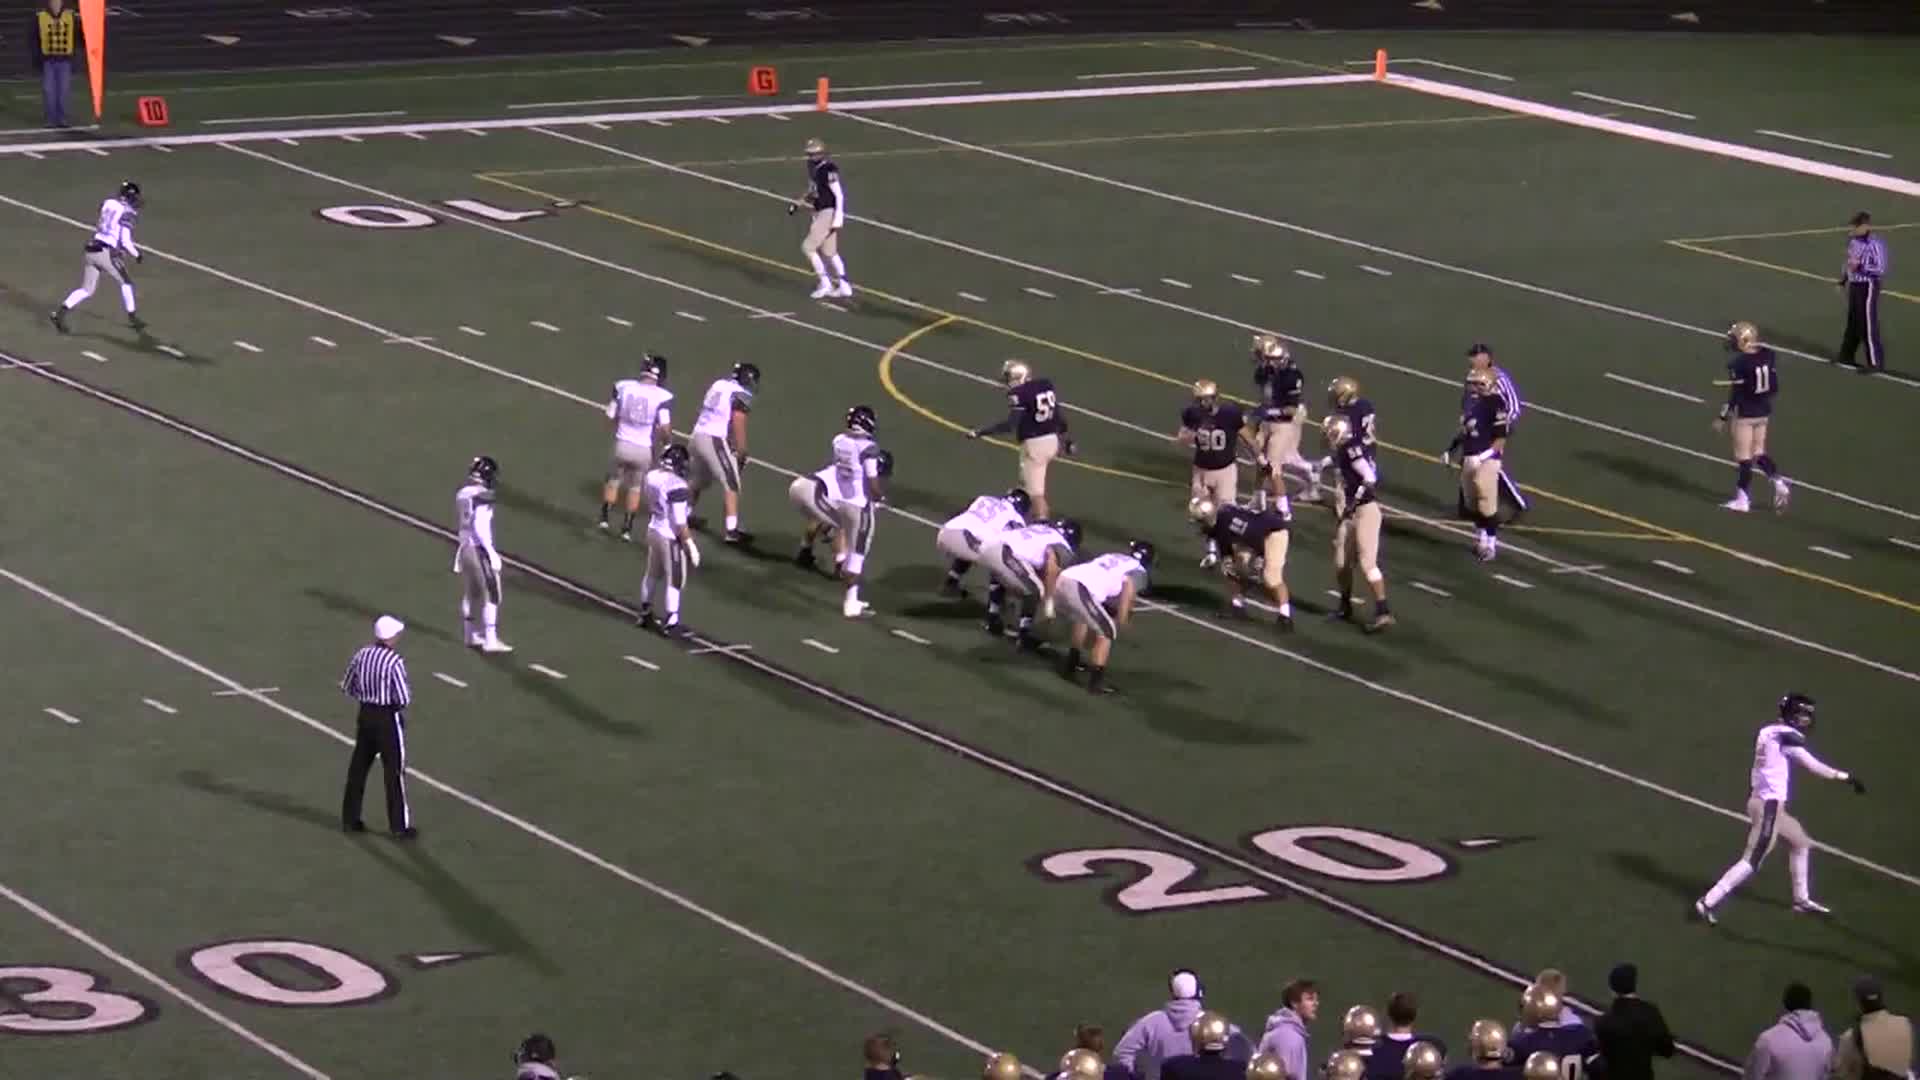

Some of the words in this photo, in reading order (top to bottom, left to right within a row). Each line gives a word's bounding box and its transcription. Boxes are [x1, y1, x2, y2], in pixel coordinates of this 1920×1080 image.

[757, 69, 773, 90] G
[145, 100, 164, 121] 10
[1754, 364, 1770, 394] 11
[1041, 825, 1448, 912] 20
[0, 940, 388, 1032] 30
